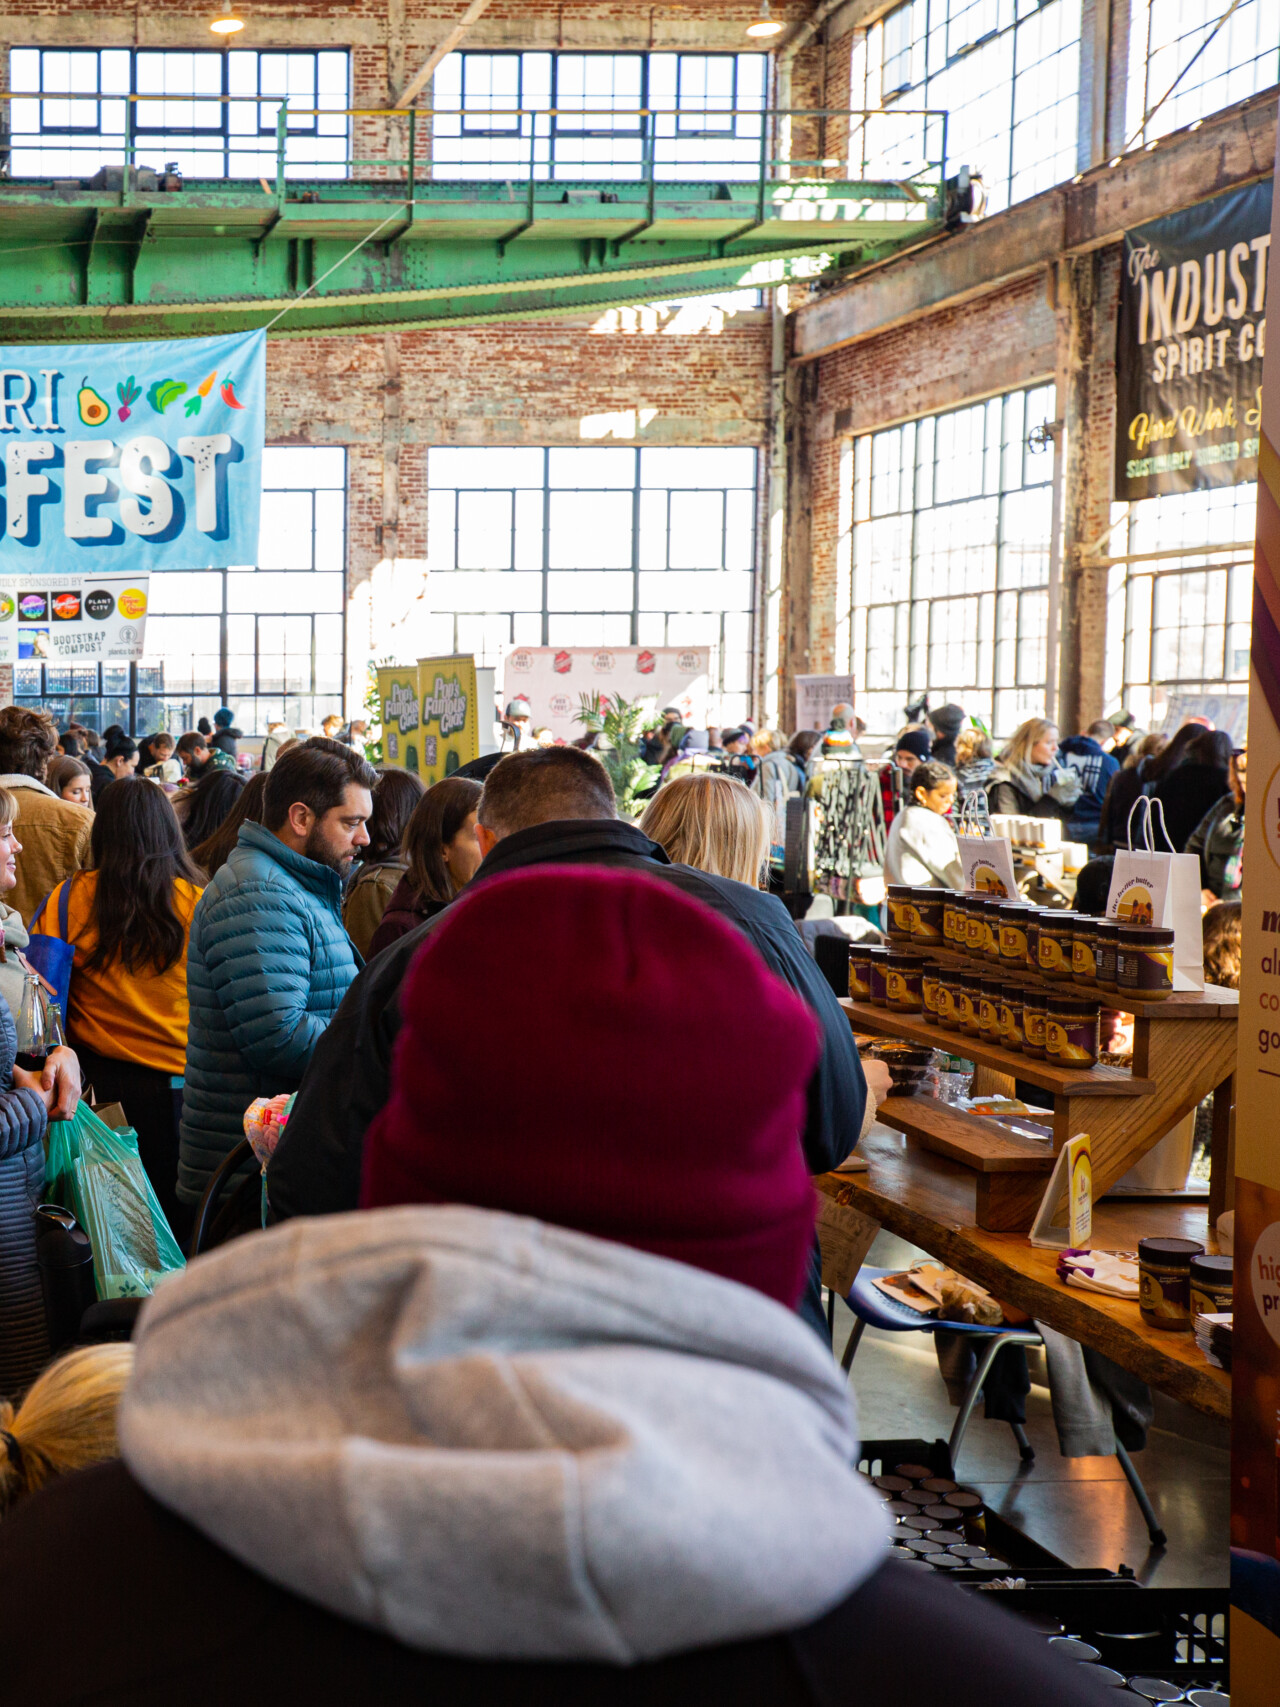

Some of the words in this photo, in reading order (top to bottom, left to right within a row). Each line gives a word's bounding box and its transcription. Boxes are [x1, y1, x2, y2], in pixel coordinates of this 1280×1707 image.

[1152, 329, 1231, 384] SPIRIT
[1128, 409, 1178, 451] Hard
[19, 576, 70, 587] SPONSORED
[71, 576, 83, 586] BY
[53, 631, 107, 646] BOOTSTRAP
[58, 642, 103, 655] COMPOST
[434, 677, 461, 701] Pop's
[424, 695, 466, 721] Famous
[1134, 876, 1155, 889] butter
